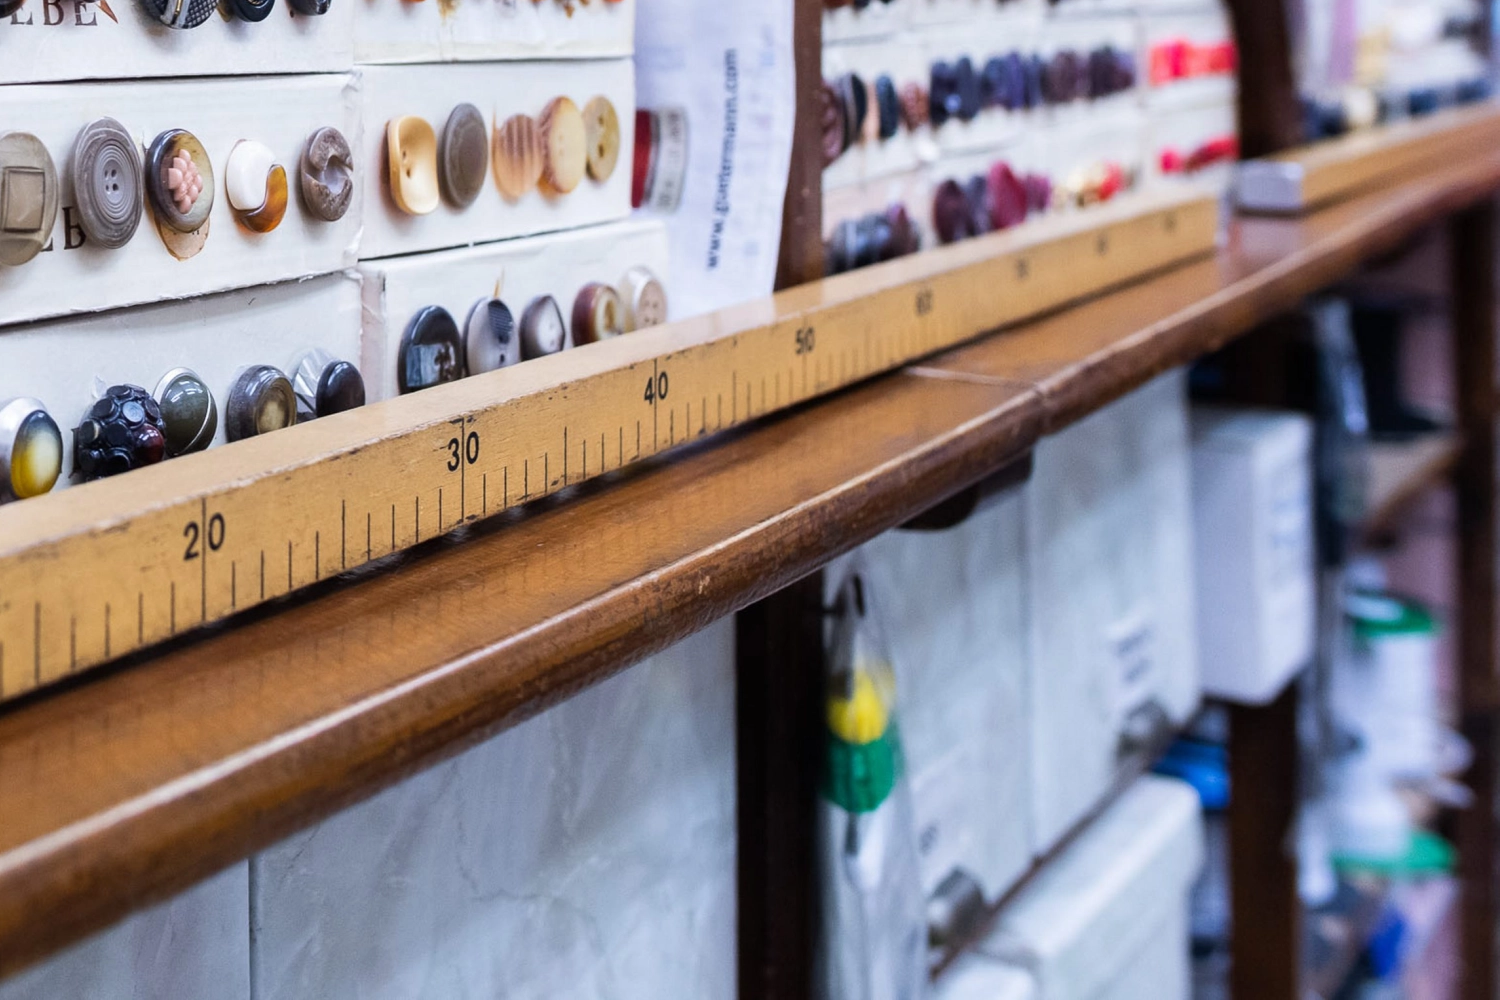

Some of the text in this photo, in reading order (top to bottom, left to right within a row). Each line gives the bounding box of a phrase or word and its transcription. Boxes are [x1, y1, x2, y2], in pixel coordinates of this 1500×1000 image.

[795, 326, 815, 354] 50
[644, 371, 669, 405] 40
[447, 431, 479, 472] 30
[183, 512, 226, 562] 20
